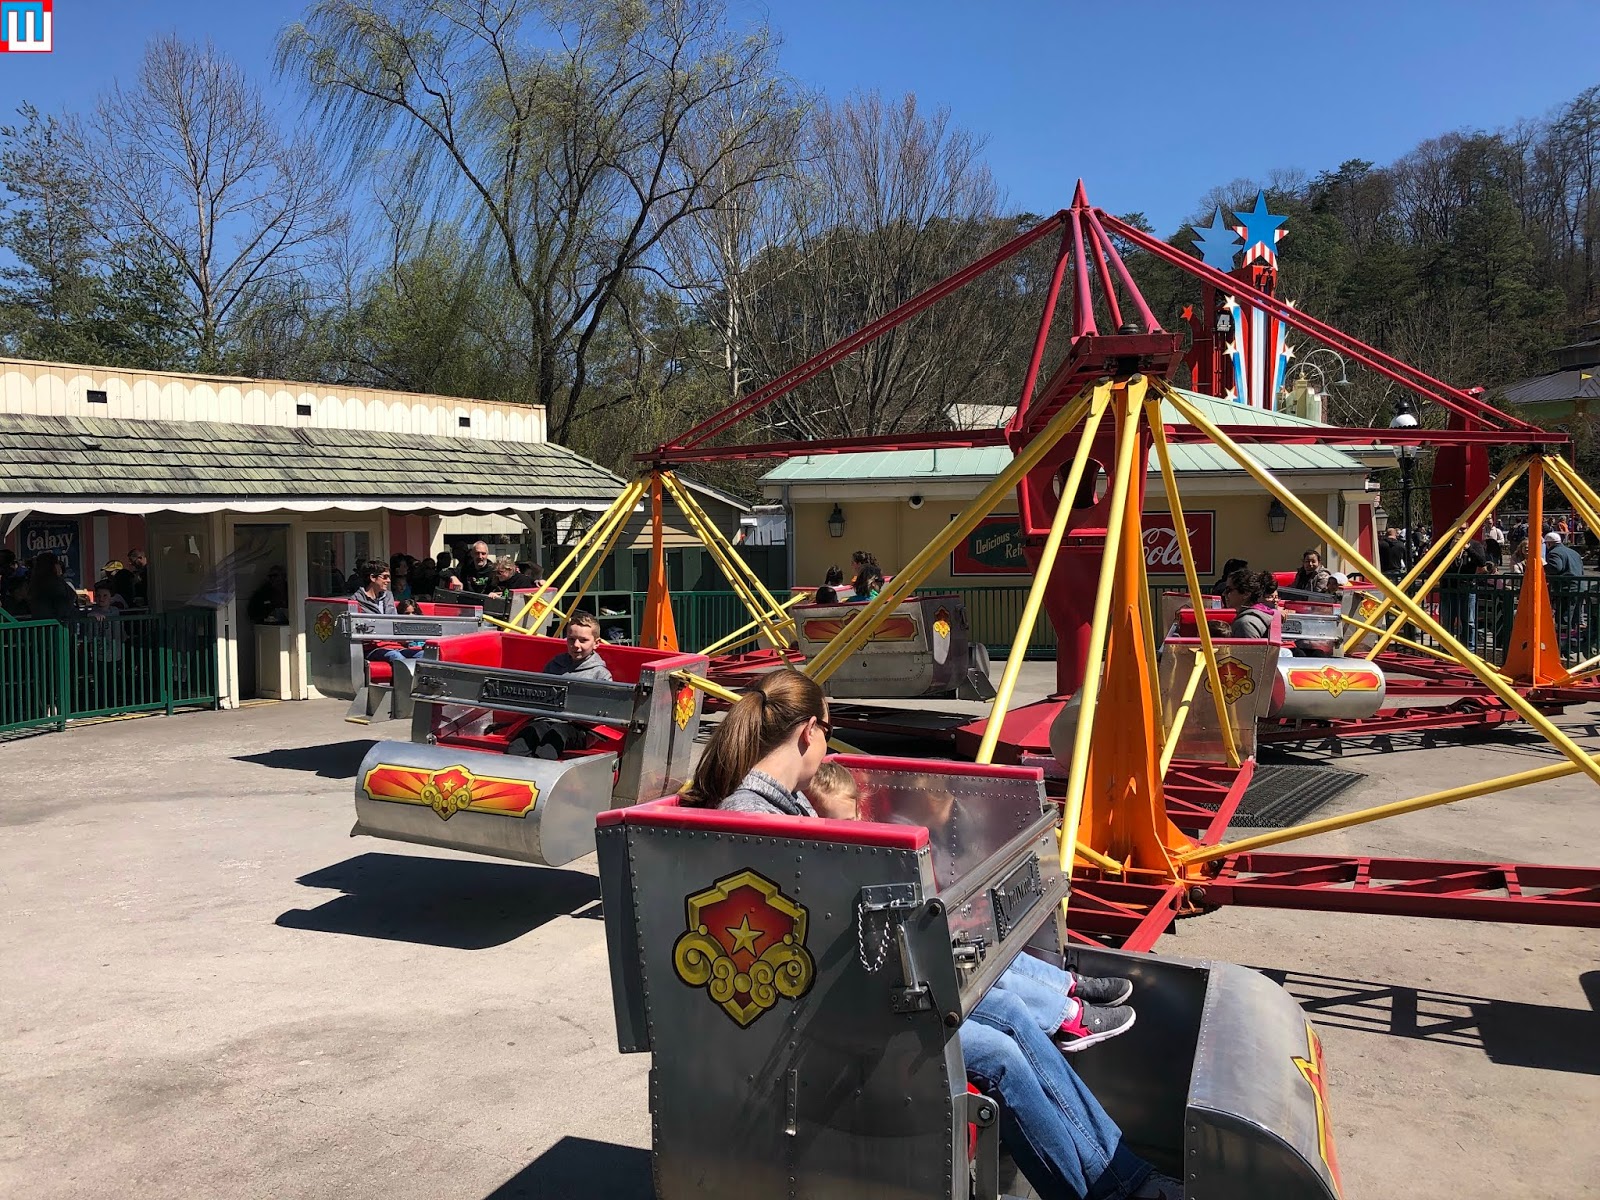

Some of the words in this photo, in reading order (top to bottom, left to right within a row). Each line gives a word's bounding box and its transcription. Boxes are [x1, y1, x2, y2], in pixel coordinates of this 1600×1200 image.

[26, 530, 73, 553] Galaxy
[975, 532, 1010, 555] Delicious
[502, 685, 547, 698] DOLLYWOOD
